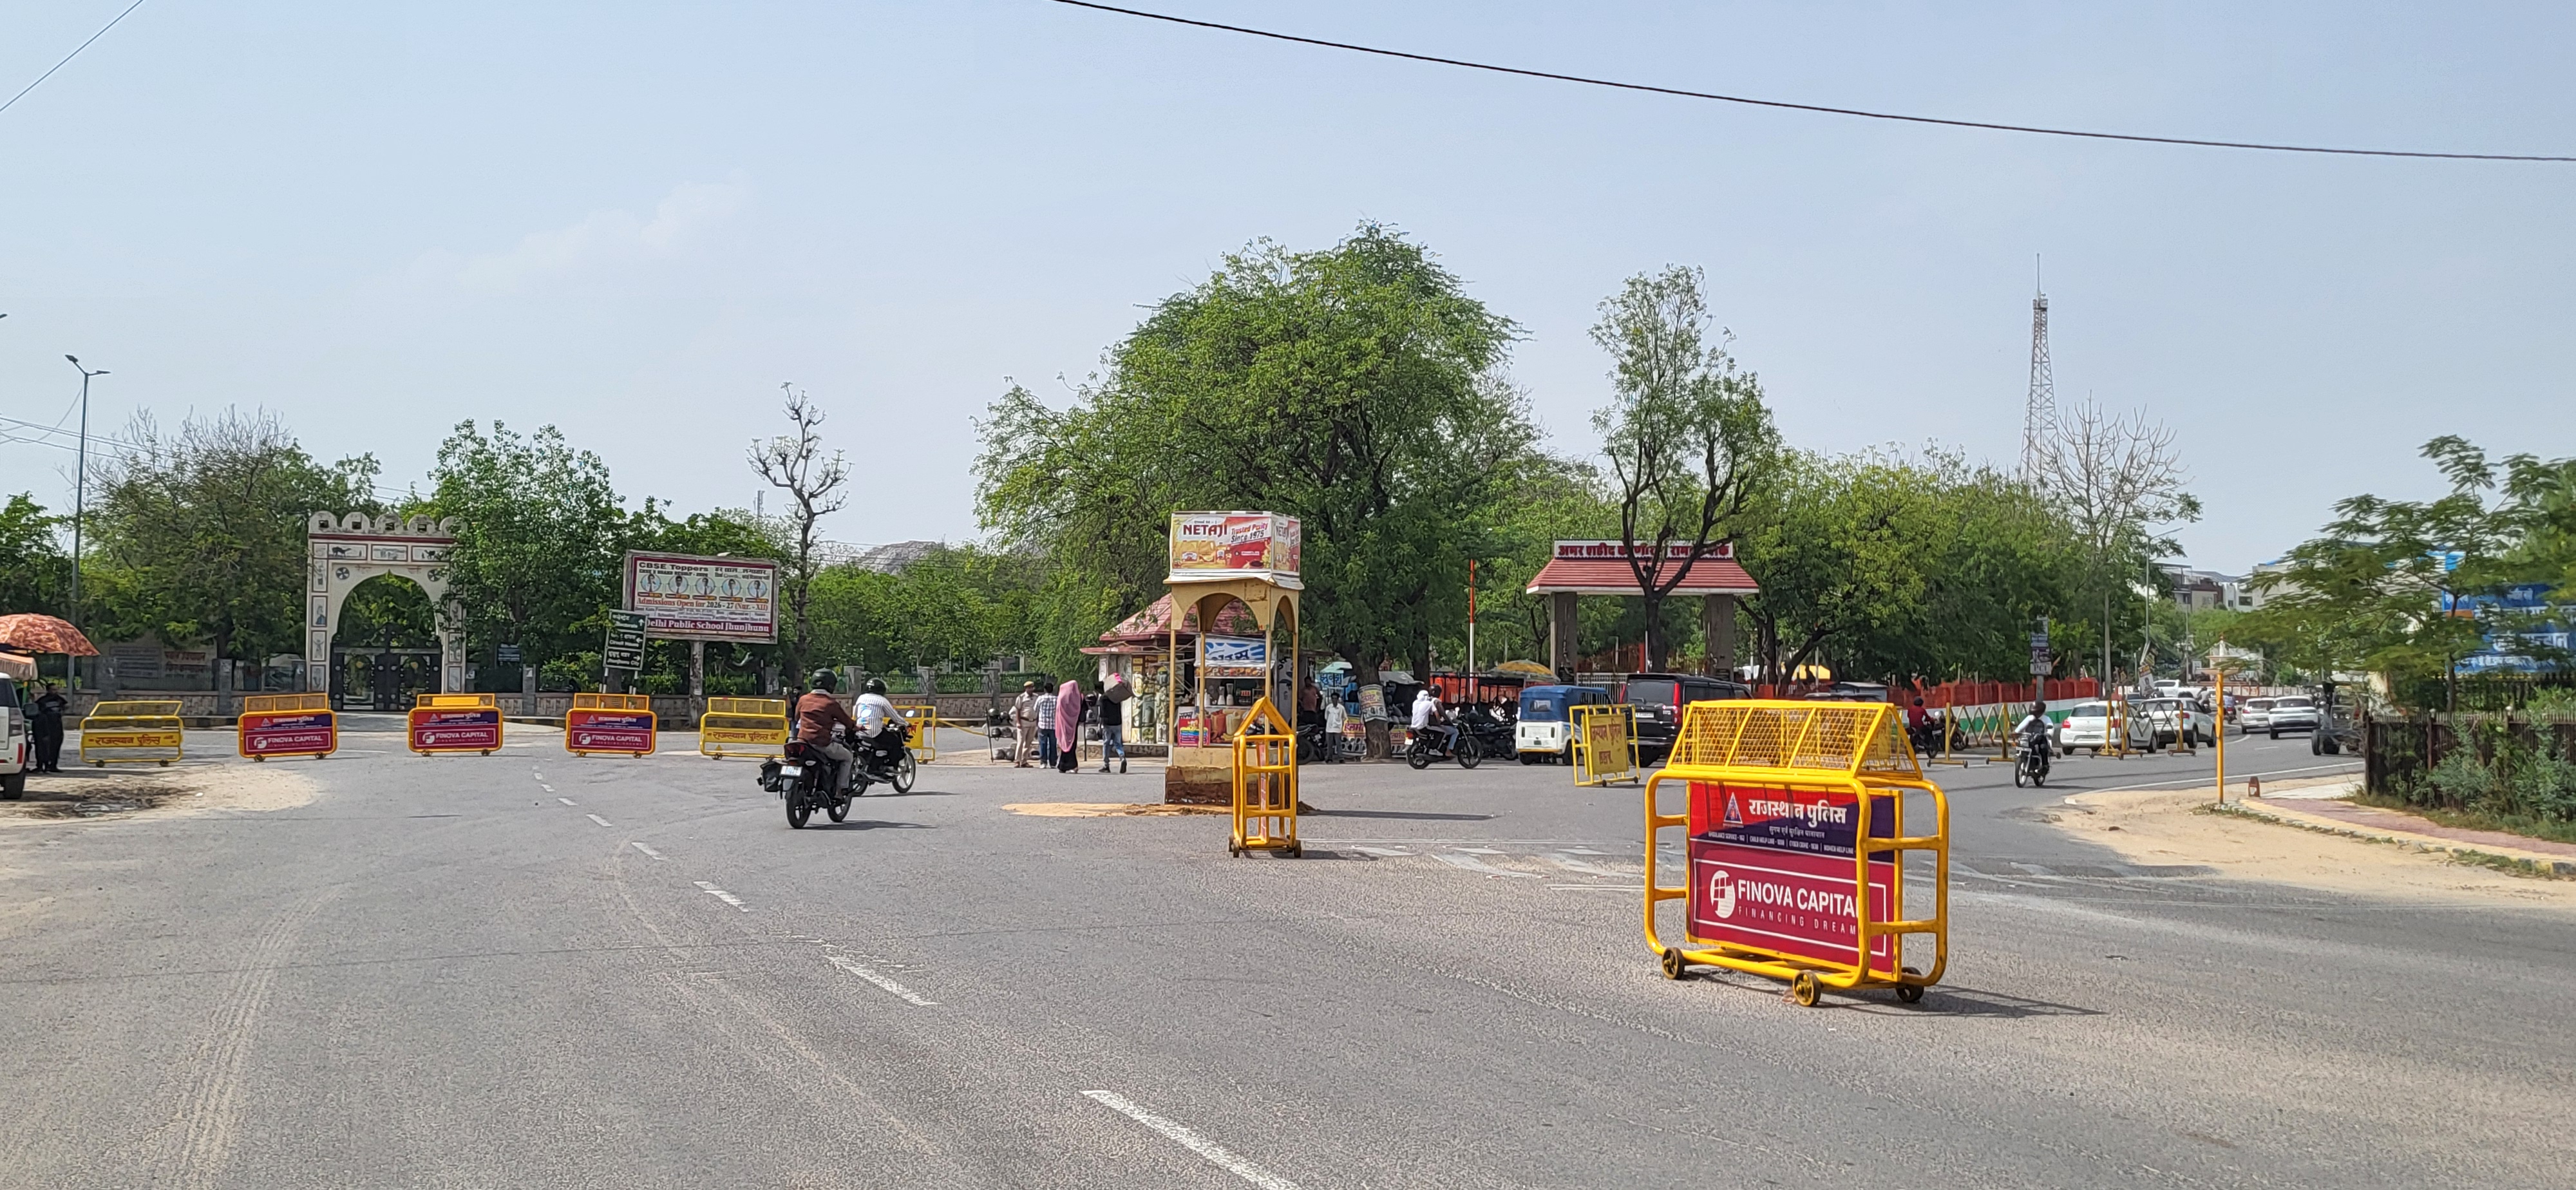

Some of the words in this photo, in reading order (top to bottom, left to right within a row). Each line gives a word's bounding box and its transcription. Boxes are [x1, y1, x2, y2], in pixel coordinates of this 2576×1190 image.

[1183, 524, 1227, 537] NETAJI
[1231, 524, 1251, 534] Trusted
[1231, 533, 1248, 543] Since
[1249, 530, 1264, 540] 1975
[1558, 545, 1584, 556] अमर
[1586, 542, 1616, 556] शहीद
[639, 562, 667, 570] CBSE
[670, 564, 708, 572] Toppers
[668, 620, 695, 628] Public
[725, 623, 770, 632] Jhunjhunu
[95, 737, 135, 746] राजस्थान
[137, 733, 161, 746] पुलिस
[713, 732, 746, 740] राजस्थान
[748, 731, 769, 741] पुलिस
[1748, 799, 1804, 820] राजस्थान
[1806, 800, 1847, 828] पुलिस
[1805, 830, 1825, 839] यातायात
[1738, 879, 1794, 908] FINOVA
[1738, 906, 1804, 927] FINANCING
[1814, 919, 1856, 935] DREAM
